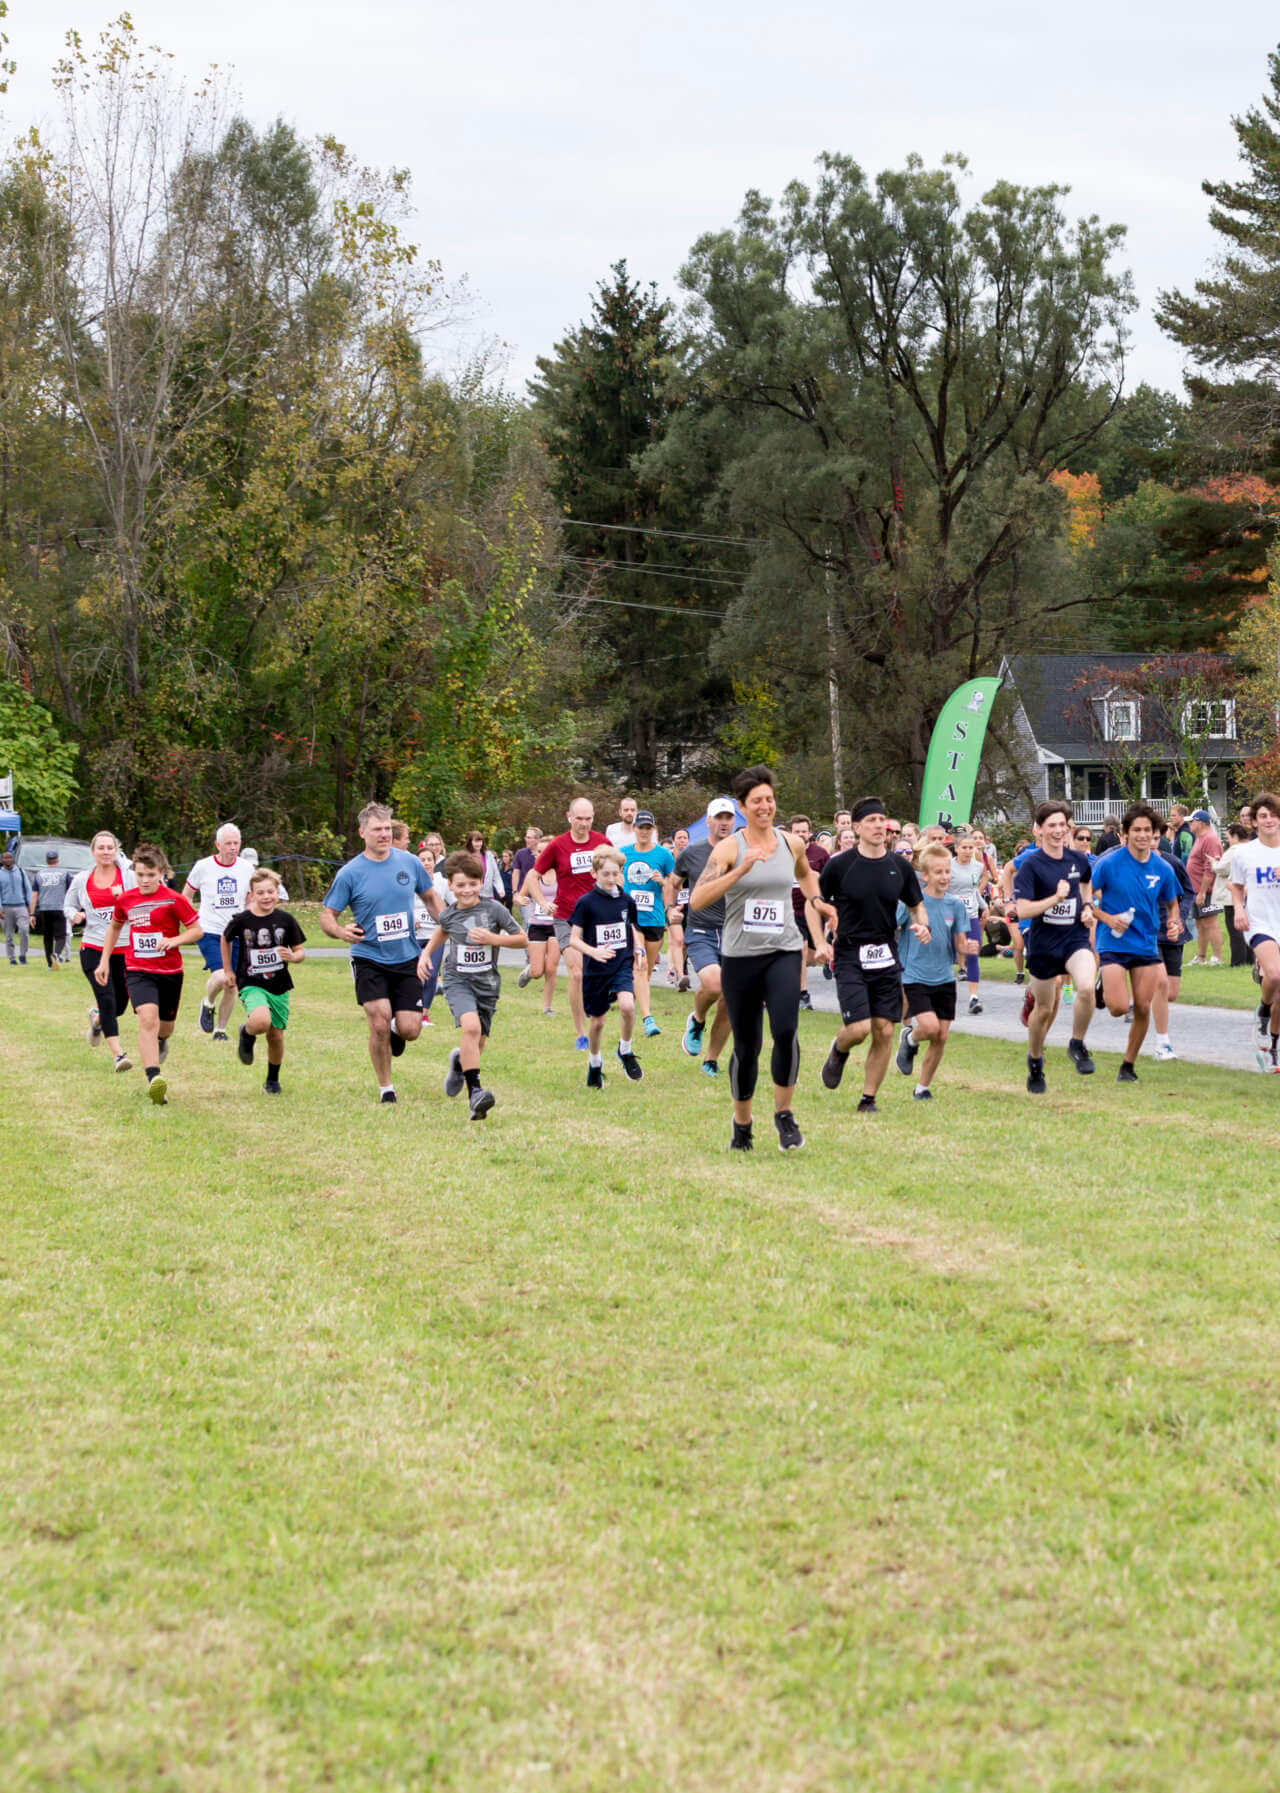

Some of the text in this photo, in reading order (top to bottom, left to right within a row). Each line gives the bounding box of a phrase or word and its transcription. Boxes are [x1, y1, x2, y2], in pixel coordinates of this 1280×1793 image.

[576, 855, 592, 866] 914
[753, 906, 776, 921] 975
[1051, 904, 1071, 915] 964
[383, 918, 402, 932] 949
[603, 928, 621, 941] 943
[138, 937, 157, 949] 948
[257, 952, 276, 965] 950
[464, 951, 485, 963] 903
